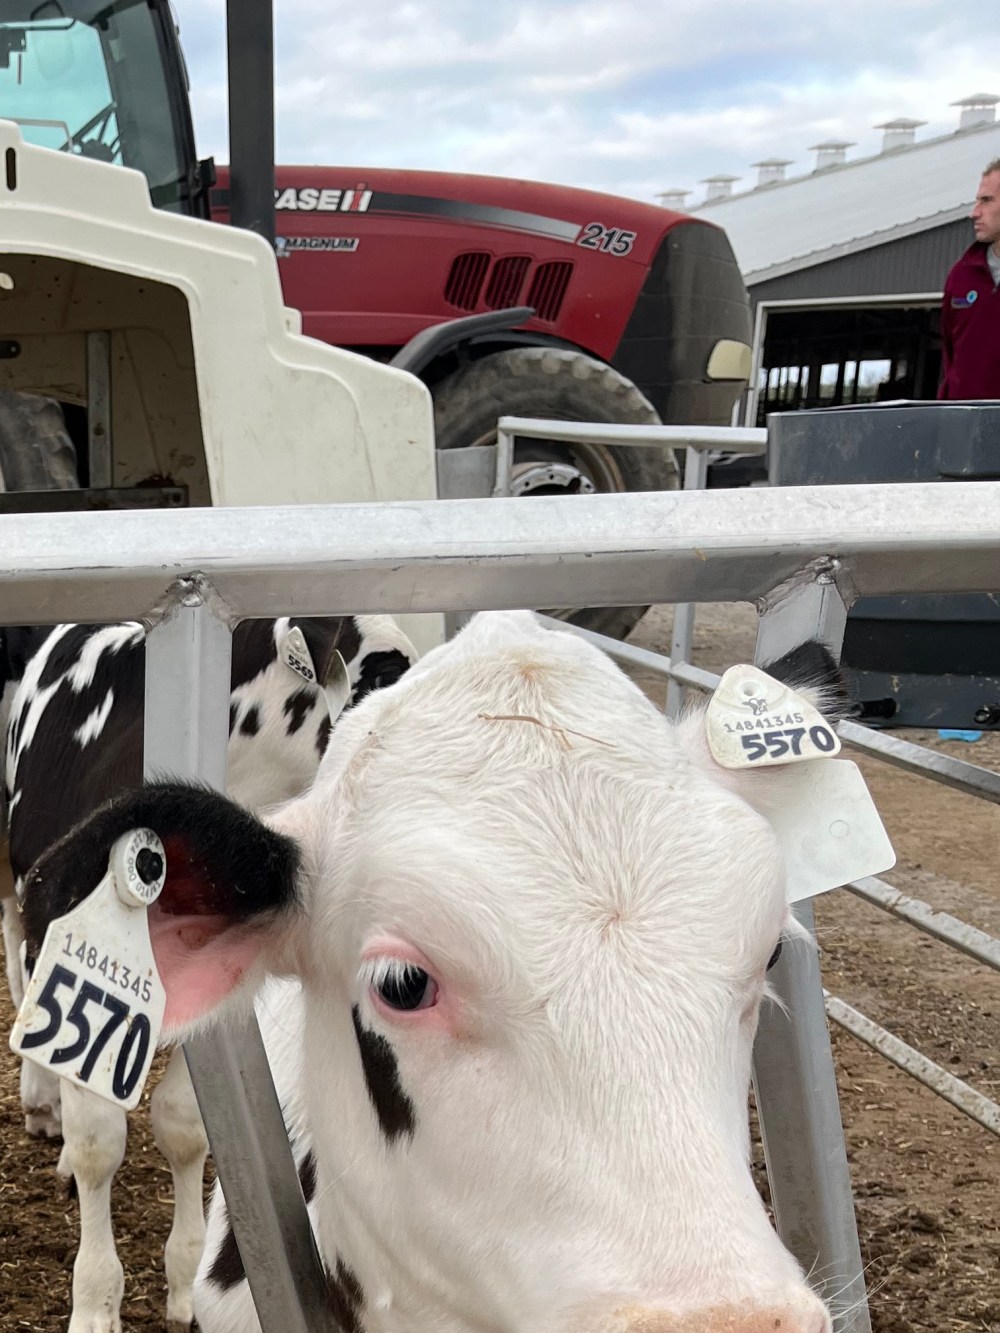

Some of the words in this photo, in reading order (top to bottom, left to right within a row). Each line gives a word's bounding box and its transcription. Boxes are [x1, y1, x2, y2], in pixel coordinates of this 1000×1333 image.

[273, 187, 342, 211] ASE
[286, 237, 358, 252] MAGNUM
[578, 223, 636, 256] 215
[288, 654, 314, 680] 5569
[723, 712, 804, 733] 14841345
[741, 725, 835, 761] 5570
[62, 932, 153, 1003] 14841345
[20, 963, 151, 1101] 5570
